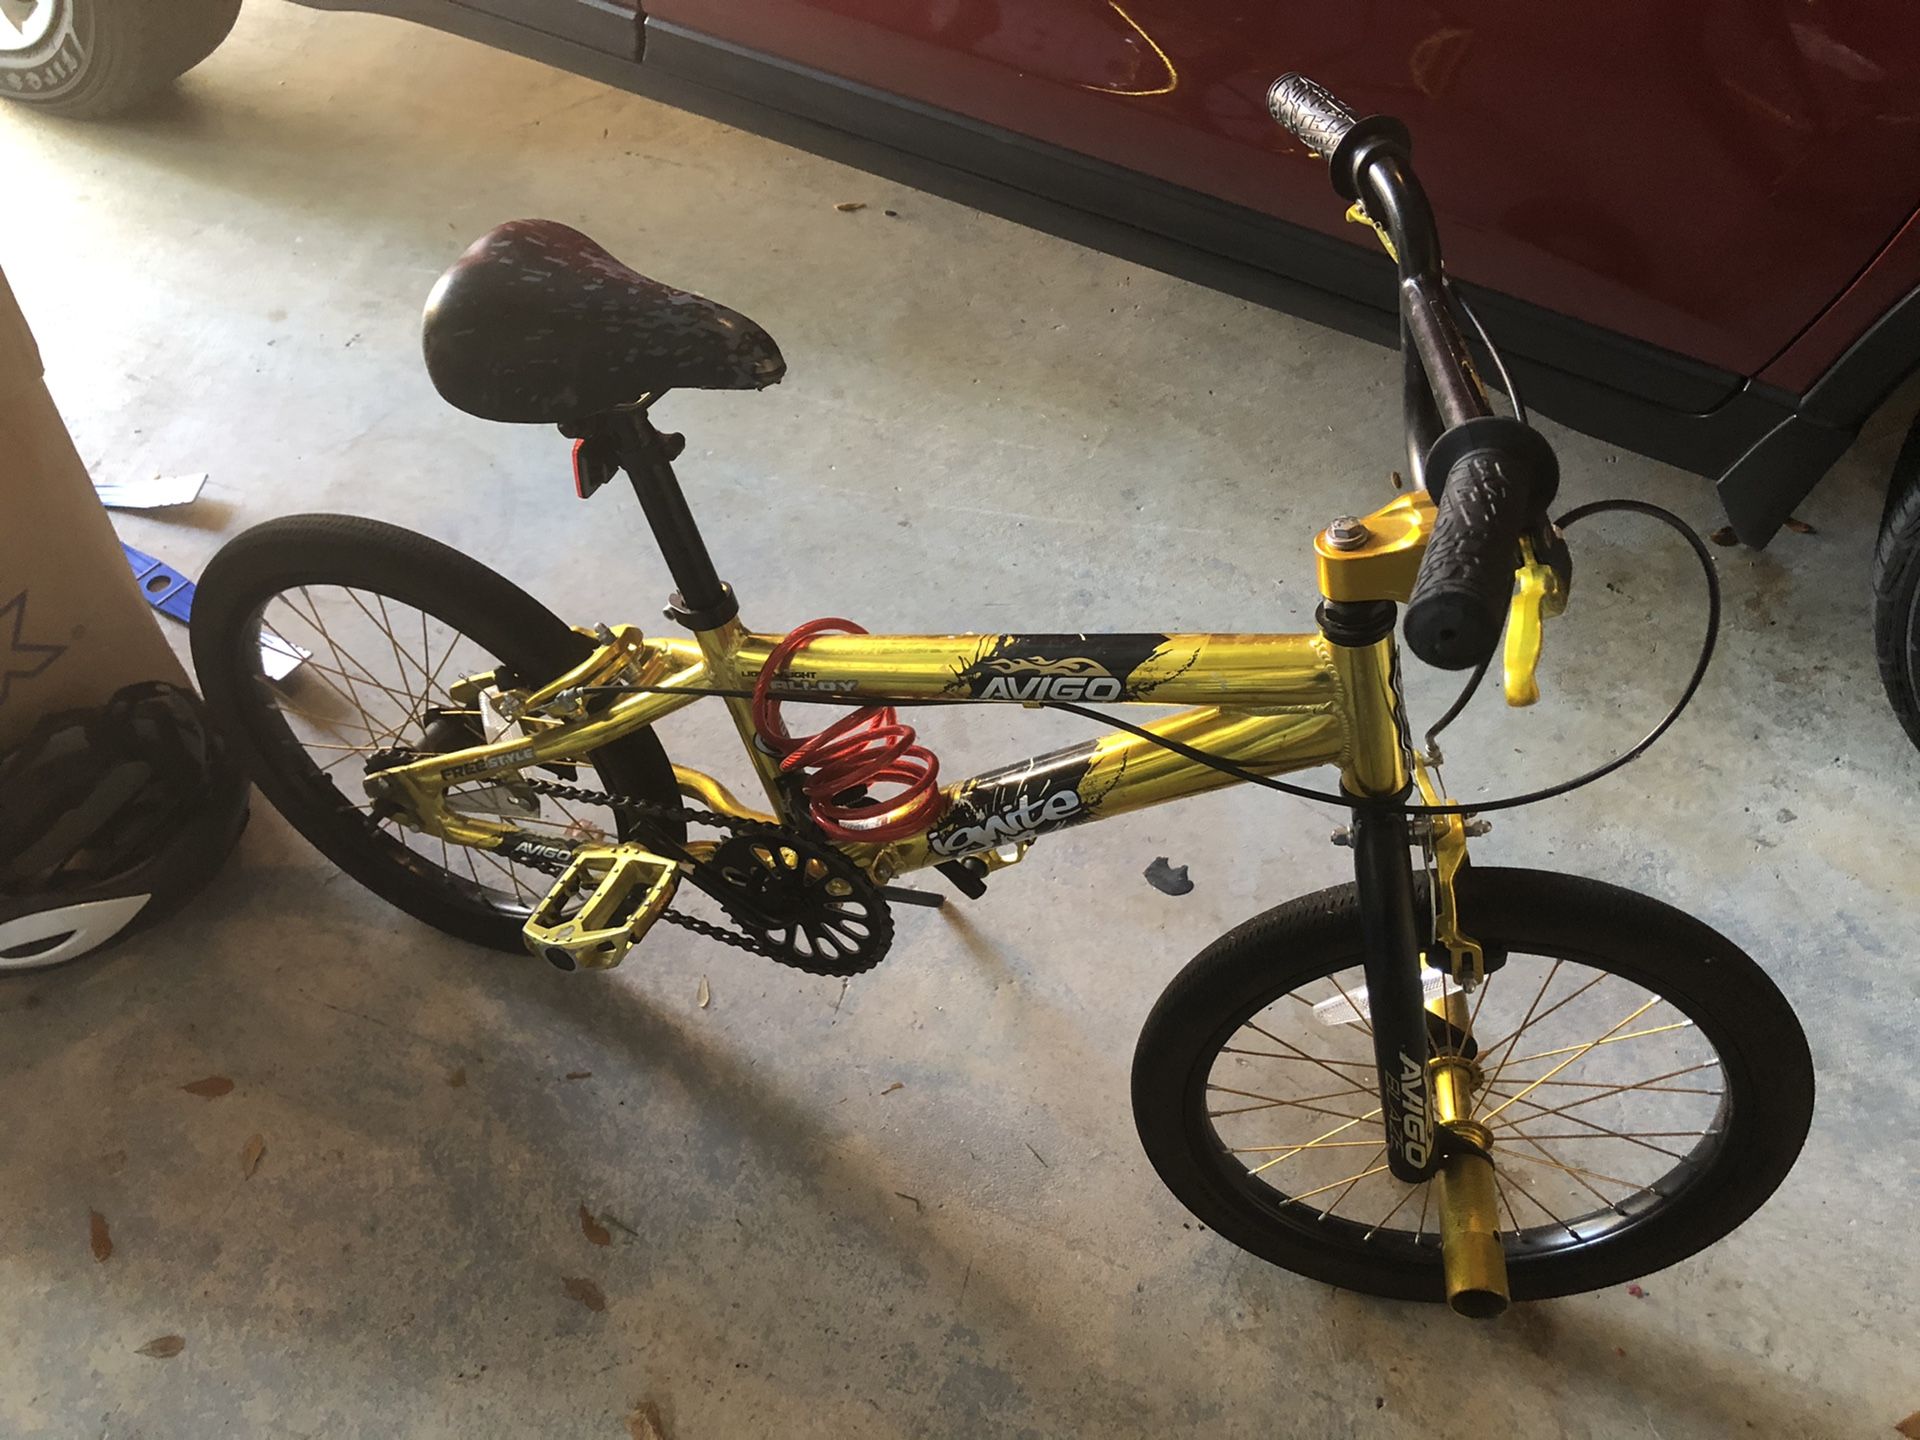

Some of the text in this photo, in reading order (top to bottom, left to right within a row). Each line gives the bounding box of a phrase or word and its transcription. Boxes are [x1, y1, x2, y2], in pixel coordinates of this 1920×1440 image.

[769, 680, 858, 692] ALLOY
[979, 677, 1121, 701] AVIGO
[441, 748, 534, 779] FREESTYLE
[515, 841, 571, 861] AVIGO
[1400, 1052, 1427, 1169] AVIGO
